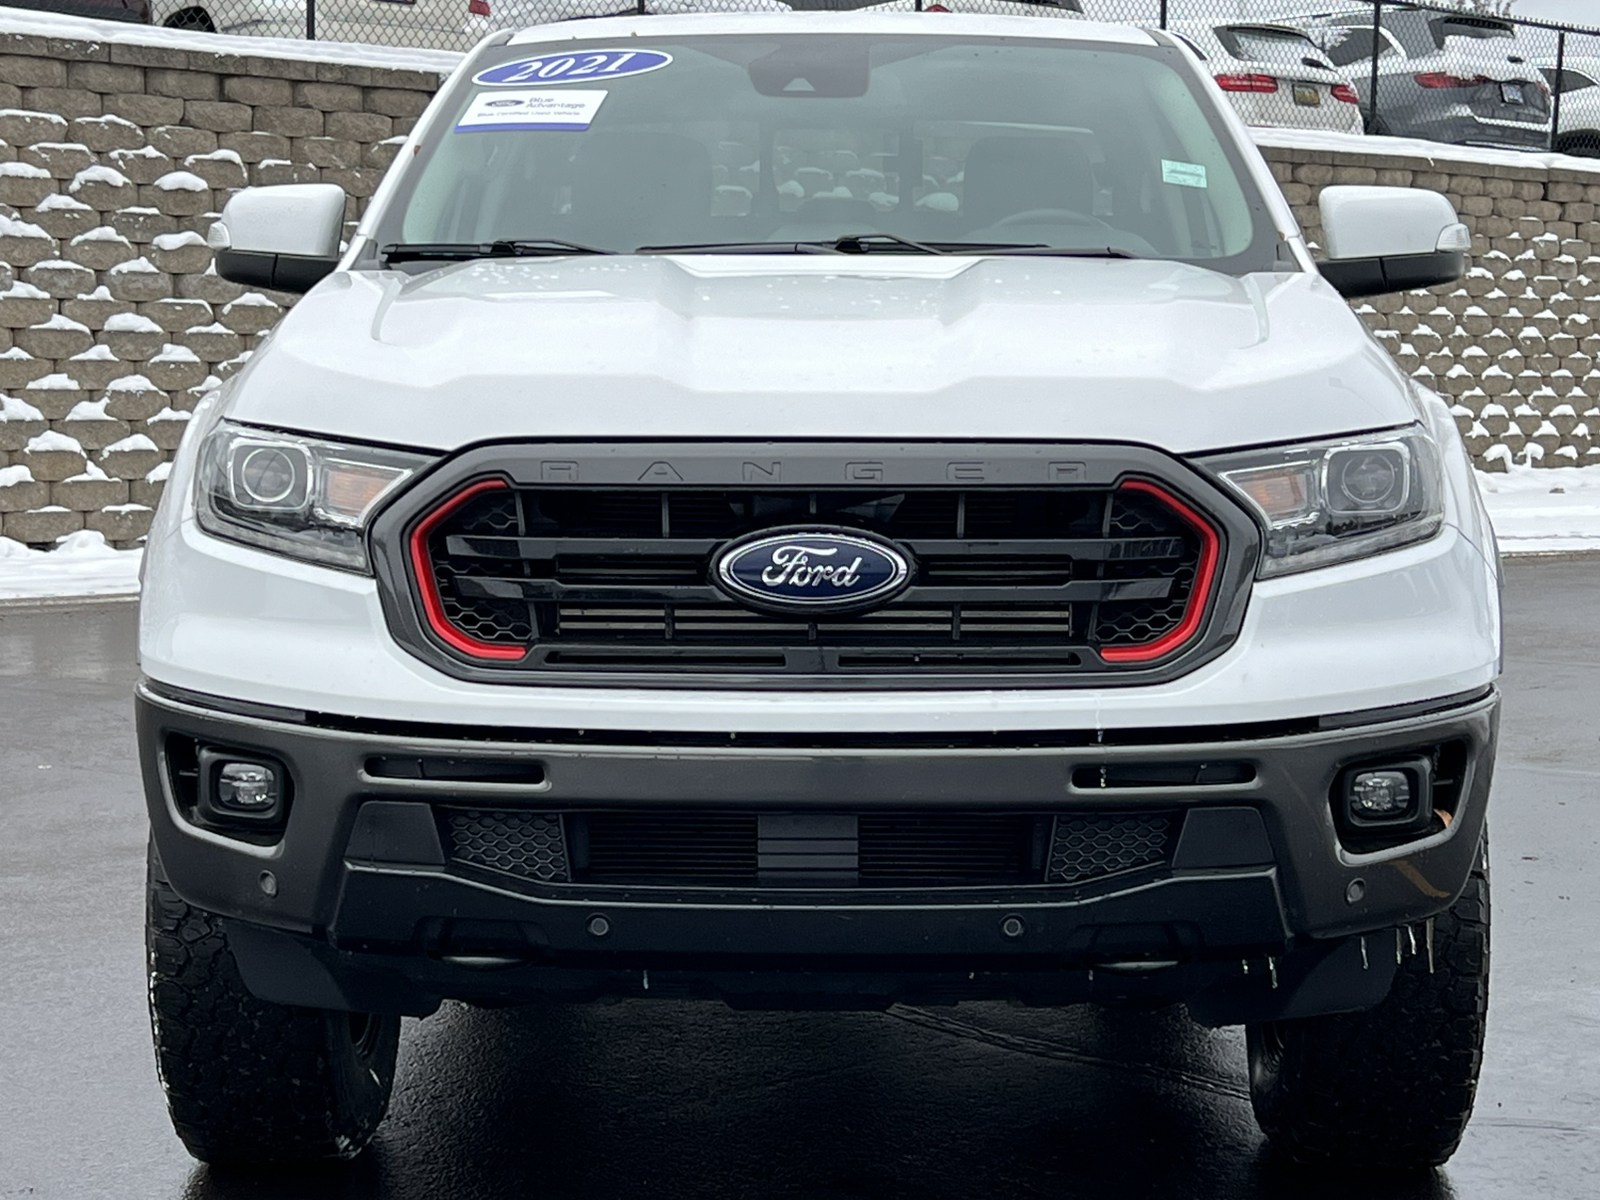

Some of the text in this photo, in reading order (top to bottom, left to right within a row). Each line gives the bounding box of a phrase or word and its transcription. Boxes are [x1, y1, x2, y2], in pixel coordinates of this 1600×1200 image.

[502, 52, 637, 83] 2021
[540, 460, 1087, 483] RANGER
[761, 545, 862, 587] Ford
